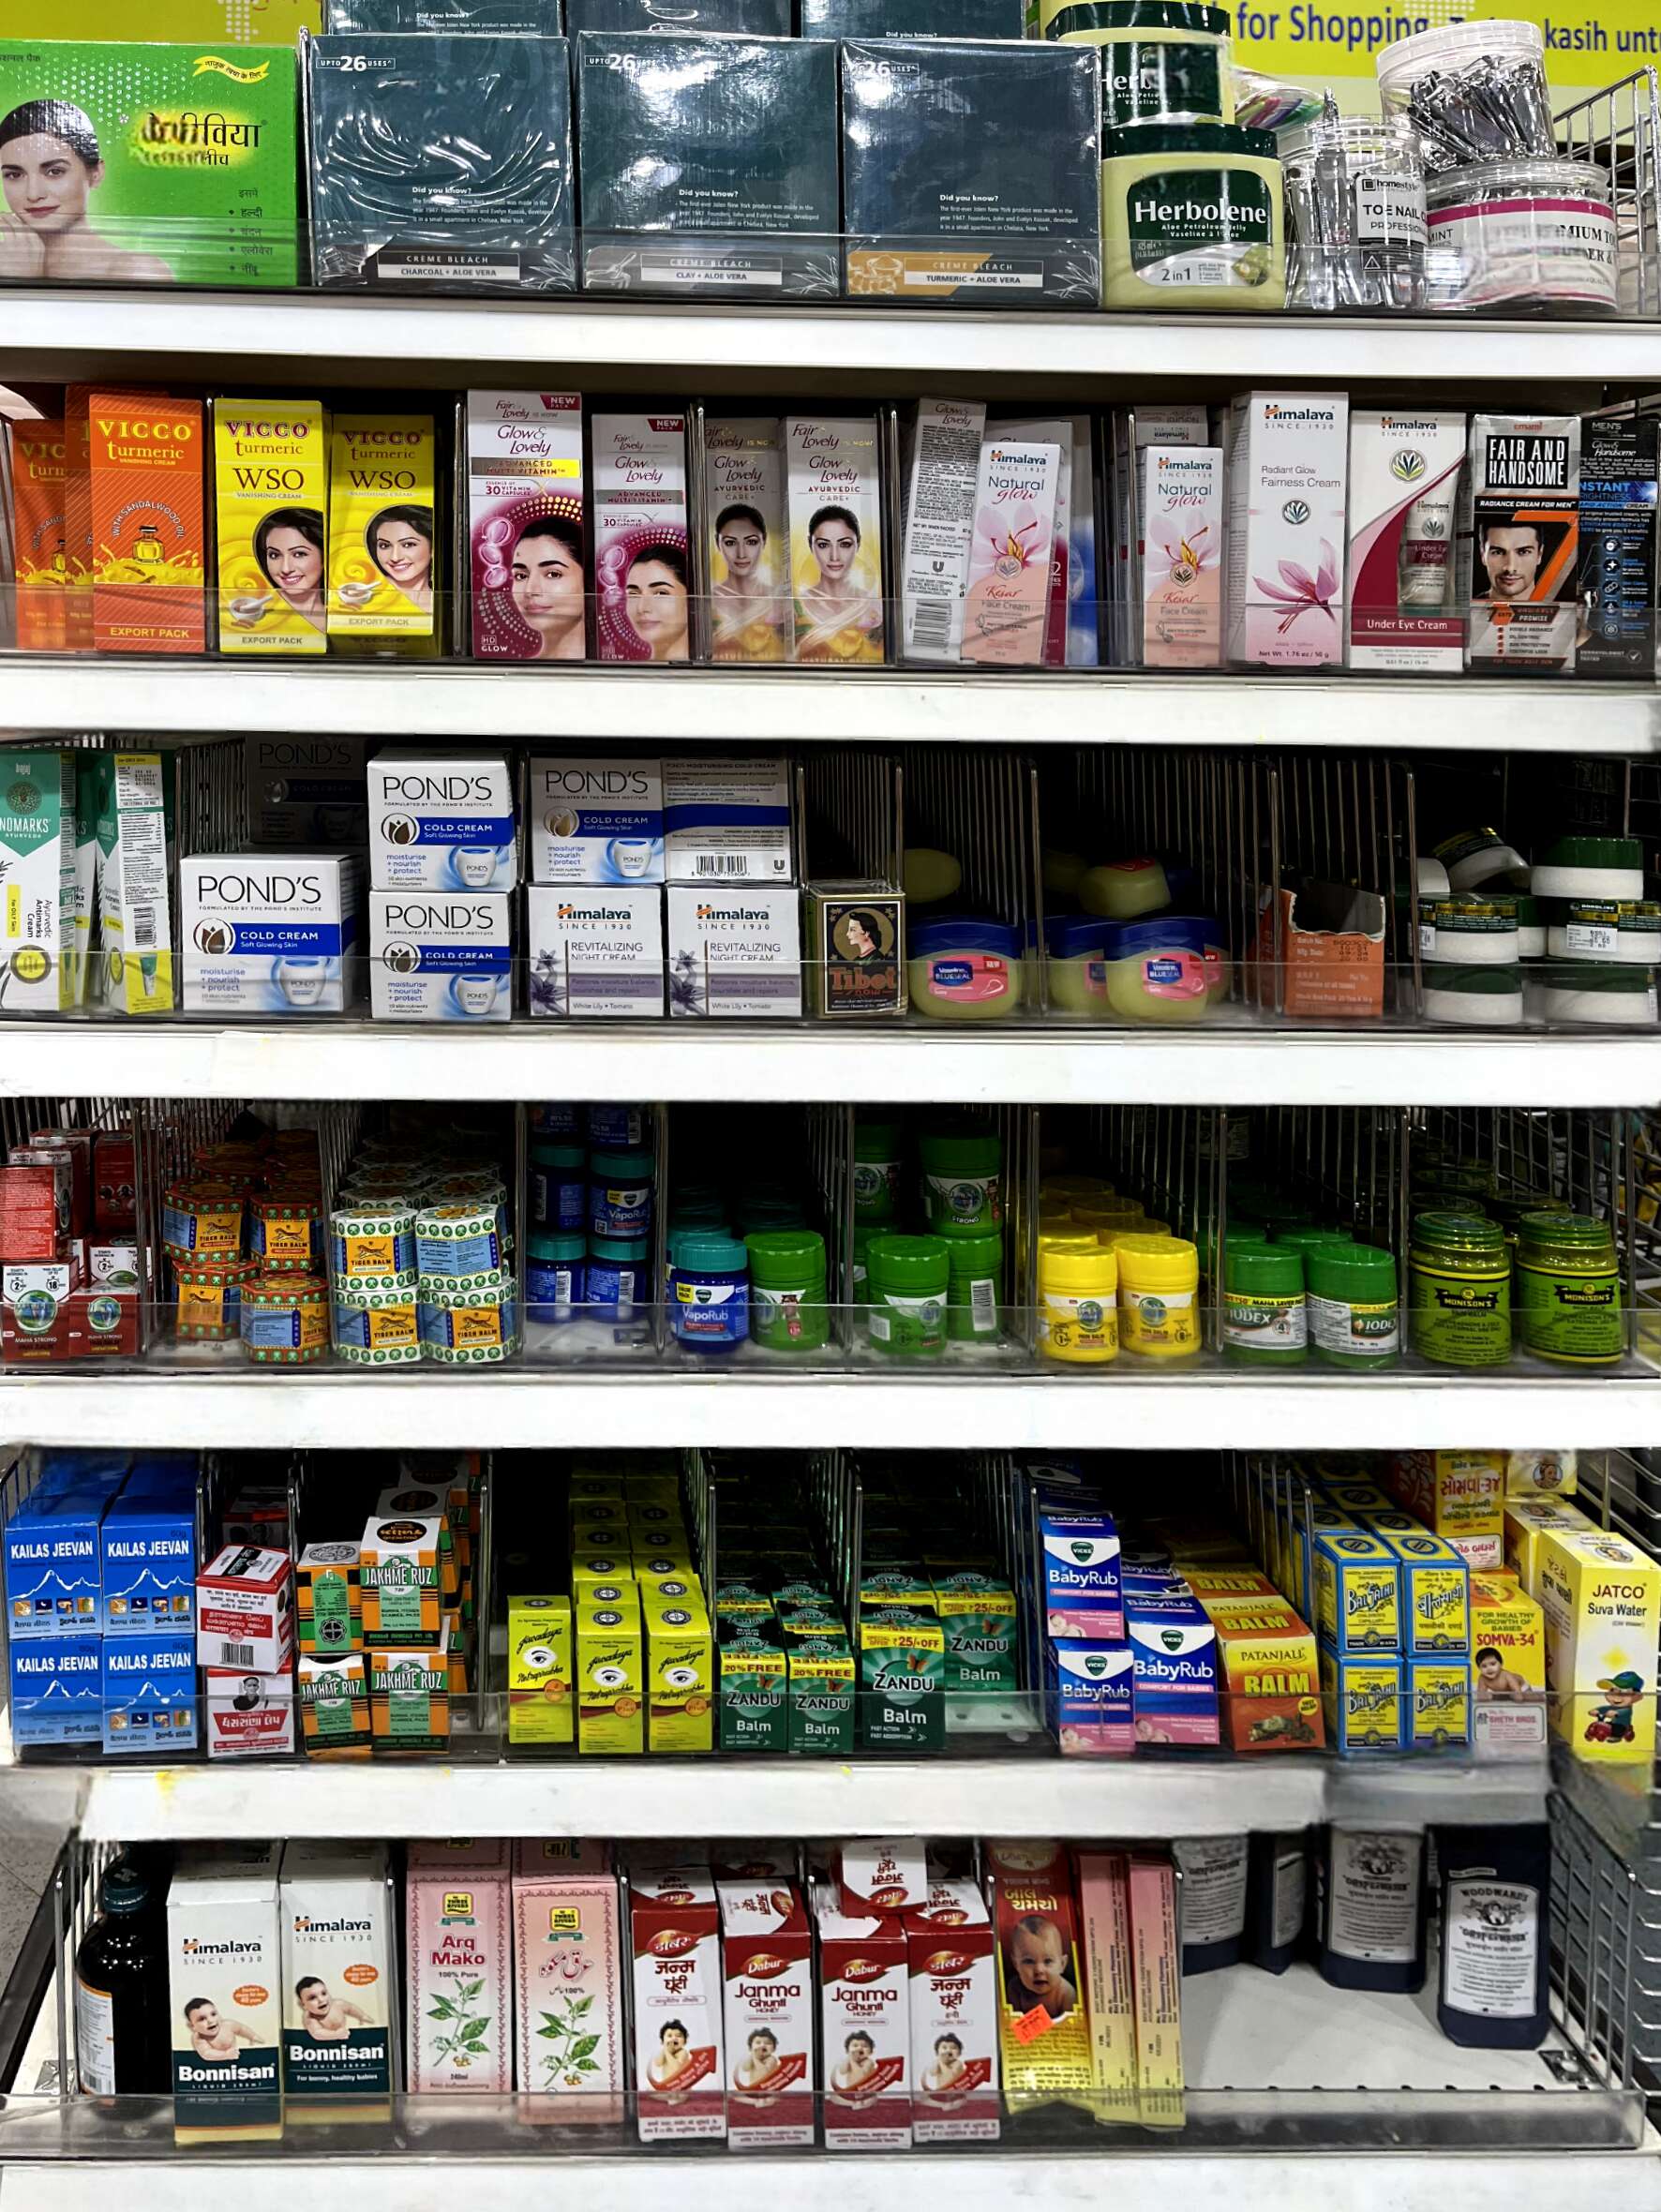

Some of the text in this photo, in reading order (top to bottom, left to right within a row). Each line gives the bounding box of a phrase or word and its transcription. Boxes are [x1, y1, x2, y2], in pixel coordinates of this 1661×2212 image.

[1237, 3, 1429, 52] for Shopping
[1545, 20, 1608, 51] kasih
[340, 55, 367, 72] 26
[1135, 198, 1266, 224] Herbolene
[1362, 203, 1419, 217] TOE NAIL
[400, 267, 443, 276] CHARCOAL
[927, 275, 967, 283] TURMERIC
[1161, 268, 1191, 280] 2 in 1
[550, 396, 576, 405] NEW
[1264, 404, 1335, 422] Himalaya
[96, 419, 192, 441] VICCO
[792, 424, 818, 437] Fair
[1514, 422, 1544, 431] emami
[1592, 422, 1622, 430] MEN'S
[105, 441, 185, 460] turmeric
[510, 440, 551, 456] Lovely
[1489, 439, 1565, 461] FAIR AND
[1594, 449, 1637, 457] Handsome
[809, 456, 843, 469] Glow
[1262, 465, 1316, 474] Radiant Glow
[232, 468, 304, 491] WSO
[1489, 461, 1564, 486] HANDSOME
[987, 476, 1045, 491] Natural
[1261, 476, 1341, 488] Fairness Cream
[486, 486, 501, 495] 30
[992, 486, 1038, 506] glow
[110, 627, 189, 638] EXPORT PACK
[1367, 619, 1448, 633] Under Eye Cream
[382, 776, 493, 800] POND'S
[0, 817, 50, 833] NOMARKS
[198, 875, 322, 904] POND'S
[44, 899, 52, 938] Ayurvedic
[557, 904, 632, 920] Himalaya
[240, 932, 319, 940] COLD CREAM
[571, 942, 643, 952] REVITALIZING
[829, 965, 897, 991] Tibet
[1564, 1293, 1610, 1302] MONISON'S
[682, 1306, 728, 1322] VapoRub
[1230, 1309, 1271, 1323] IODEX
[11, 1540, 93, 1560] KAILAS JEEVAN
[365, 1568, 432, 1585] JAKHME RUZ
[1050, 1570, 1118, 1588] BabyRub
[1593, 1585, 1644, 1599] JATCO
[1588, 1603, 1647, 1617] Suva Water
[951, 1637, 1008, 1652] ZANDU
[1477, 1634, 1534, 1646] SOMVA-34
[1241, 1649, 1304, 1661] PATANJALI
[724, 1663, 783, 1673] 20% FREE
[874, 1673, 934, 1691] ZANDU
[1245, 1673, 1310, 1697] BALM
[884, 1709, 926, 1725] Balm
[294, 1916, 372, 1933] Himalaya
[441, 1935, 475, 1951] Arq
[431, 1952, 486, 1965] Mako
[748, 1958, 784, 1974] Dabur
[654, 1959, 696, 1974] जन्म
[735, 1983, 801, 1998] Janma
[290, 2043, 383, 2062] Bonnisan
[331, 2073, 355, 2083] healthy
